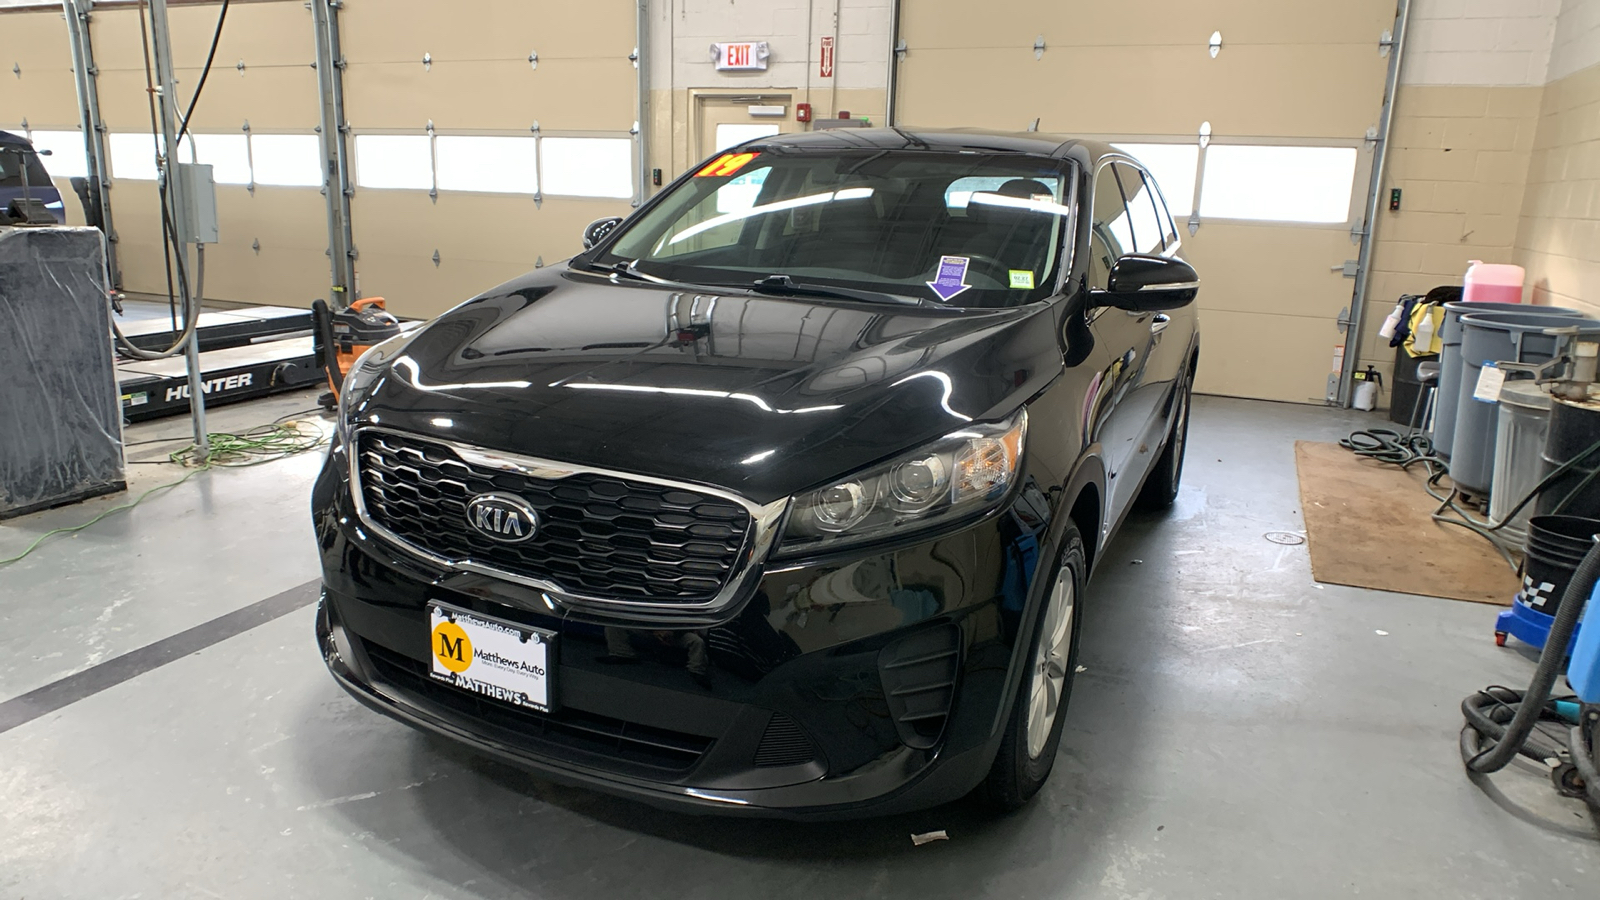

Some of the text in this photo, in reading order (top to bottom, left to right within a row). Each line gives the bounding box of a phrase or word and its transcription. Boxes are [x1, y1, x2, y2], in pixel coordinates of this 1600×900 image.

[727, 44, 751, 66] EXIT
[698, 153, 754, 176] 19
[476, 504, 523, 536] KIA
[451, 612, 521, 638] MatthewsAuto.com
[438, 632, 465, 662] M
[473, 647, 545, 676] Matthews Auto
[455, 676, 521, 705] MATTHEWS
